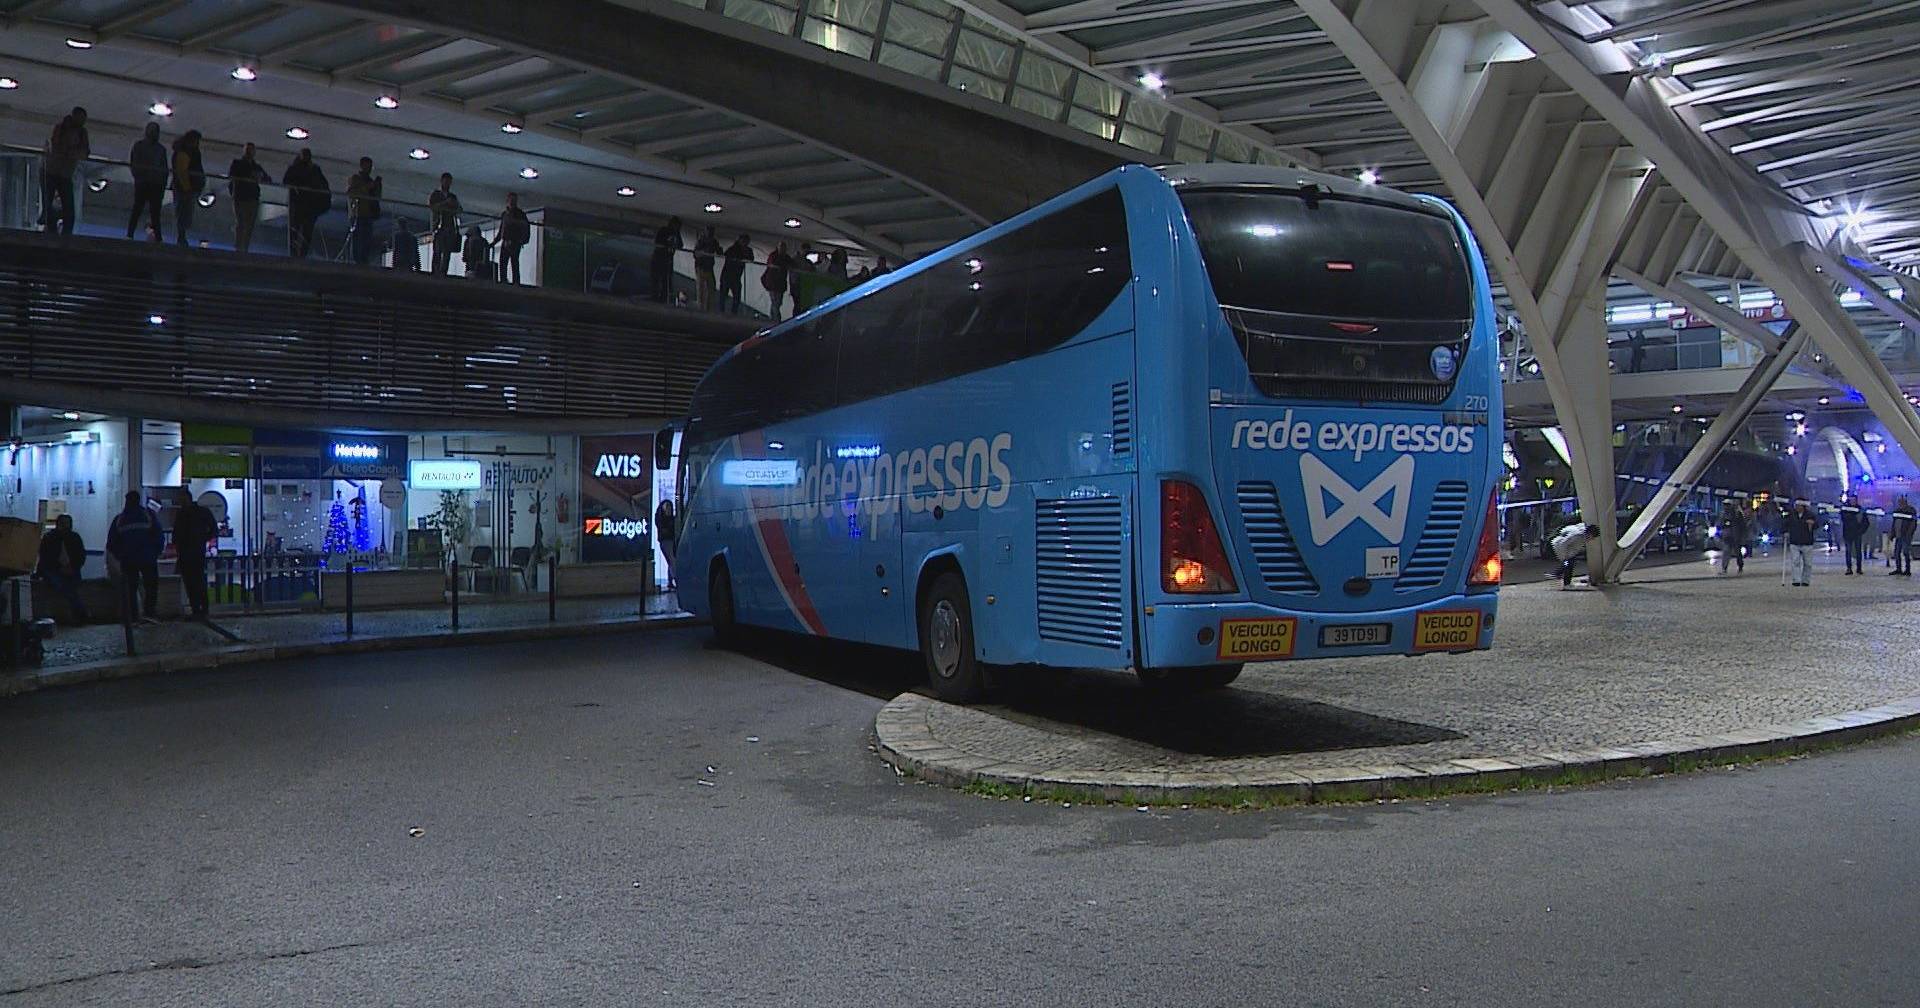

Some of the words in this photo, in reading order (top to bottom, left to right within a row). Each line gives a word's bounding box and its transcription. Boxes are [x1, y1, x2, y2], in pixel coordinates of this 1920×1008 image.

[1464, 395, 1488, 411] 270
[1231, 408, 1311, 450] rede
[1317, 419, 1475, 463] expressos
[596, 453, 642, 478] AVIS
[840, 432, 1013, 542] expressos
[602, 517, 648, 539] Budget
[1381, 555, 1399, 570] TP
[1423, 615, 1474, 630] VEICULO
[1229, 623, 1288, 638] VEICULO
[1424, 630, 1468, 644] LONGO
[1231, 639, 1281, 654] LONGO
